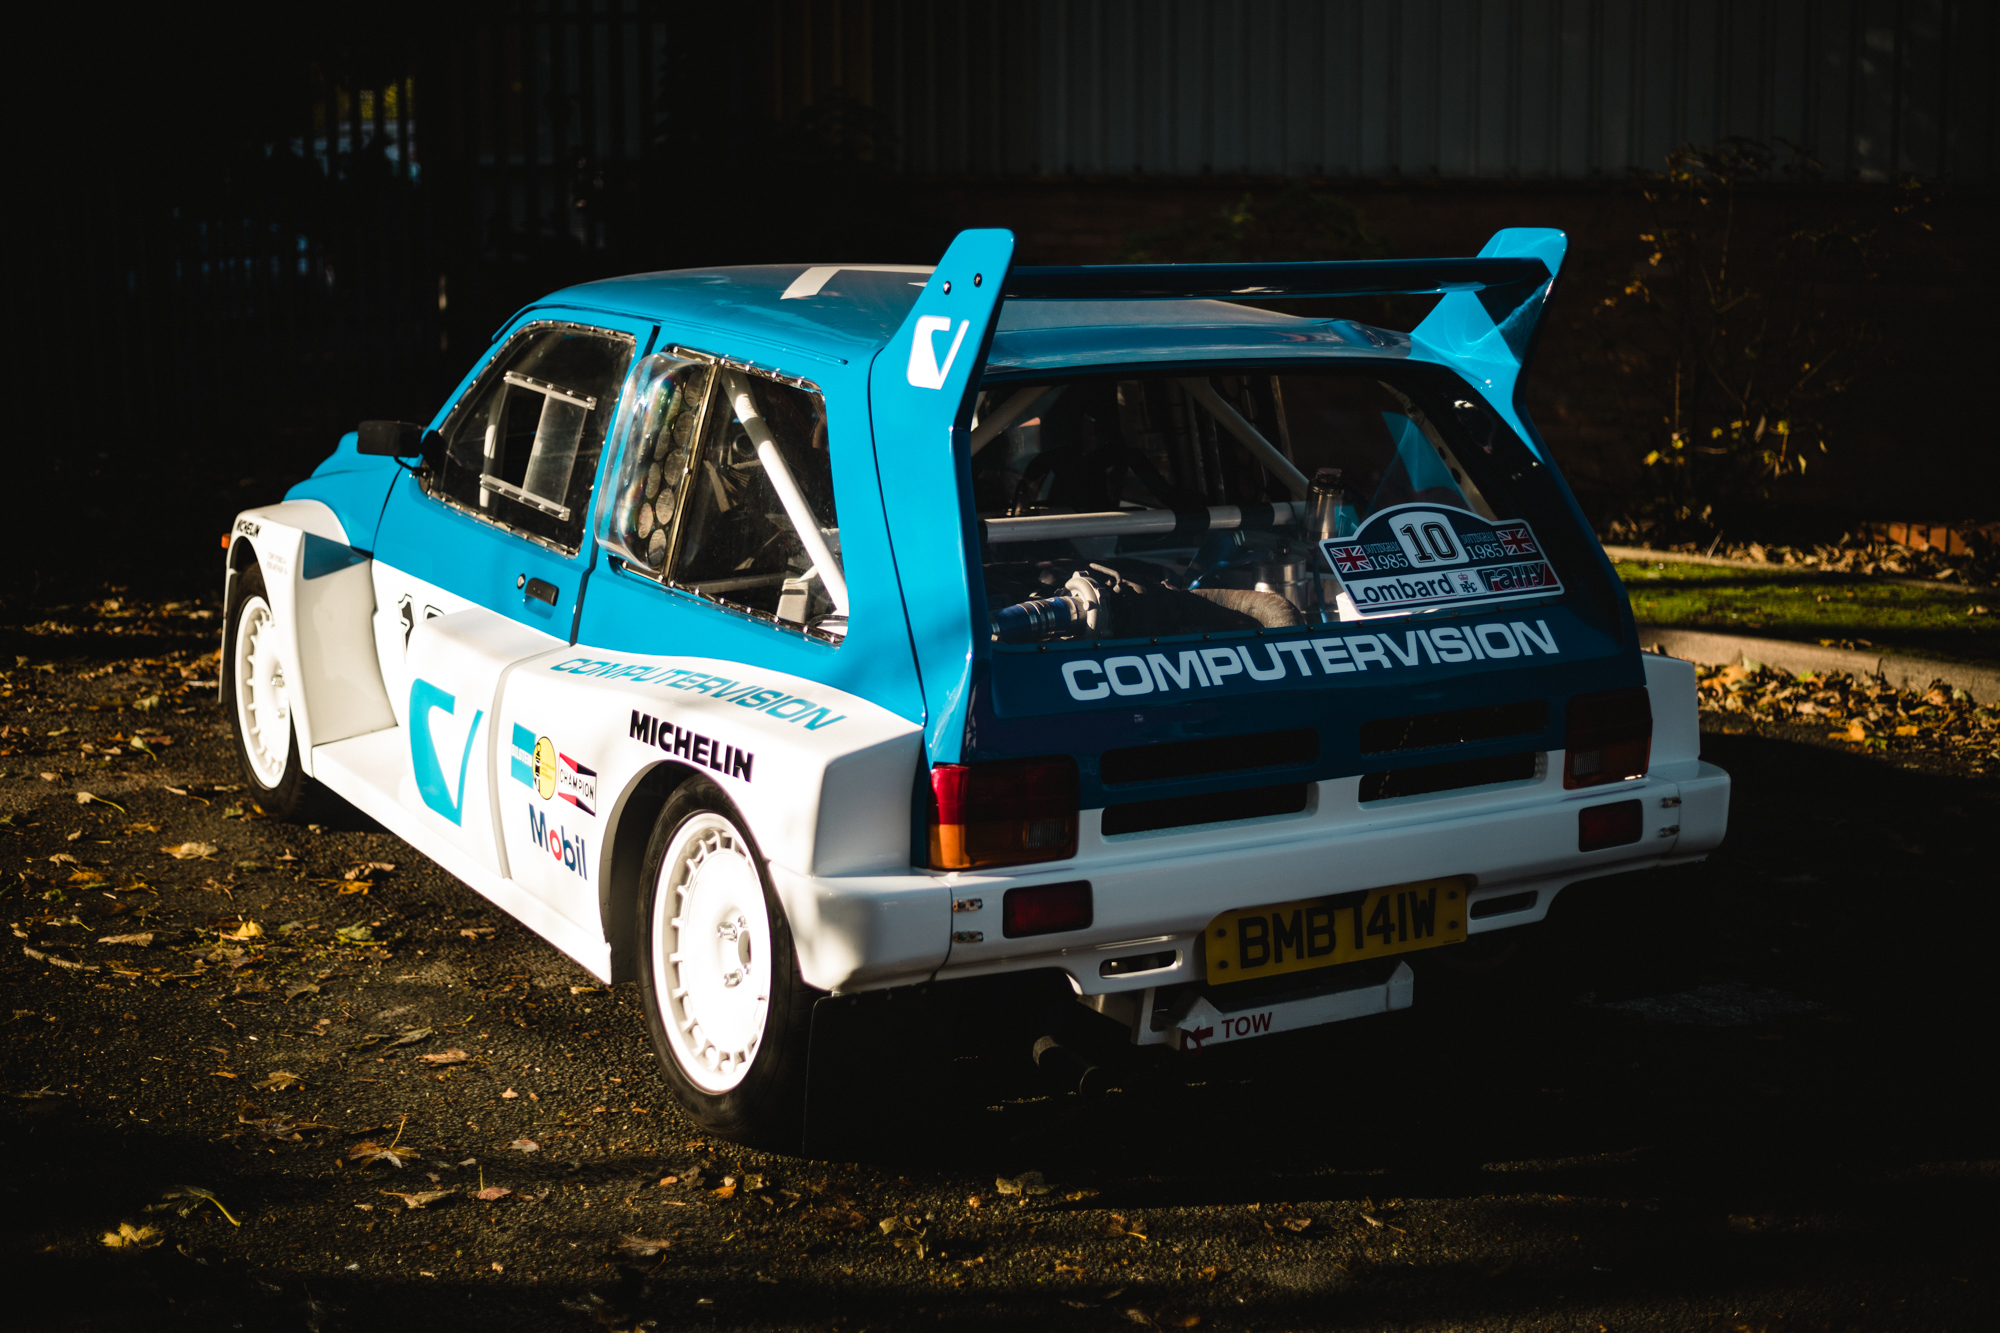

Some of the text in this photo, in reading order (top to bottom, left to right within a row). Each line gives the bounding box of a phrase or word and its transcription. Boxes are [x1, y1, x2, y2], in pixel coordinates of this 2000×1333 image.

[1363, 540, 1400, 555] NOTTINGHAM
[1400, 521, 1458, 564] 10
[1460, 531, 1496, 545] NOTTINGHAM
[1466, 543, 1504, 560] 1985
[1369, 553, 1409, 570] 1985
[1346, 573, 1455, 605] Lombard
[1482, 562, 1546, 592] rally
[1061, 620, 1560, 701] COMPUTERVISION
[550, 658, 847, 731] COMPUTERVISION
[629, 709, 755, 783] MICHELIN
[559, 768, 595, 800] CHAMPION
[529, 802, 588, 881] Mobil
[1238, 904, 1336, 969] BMB
[1221, 1012, 1272, 1038] TOW
